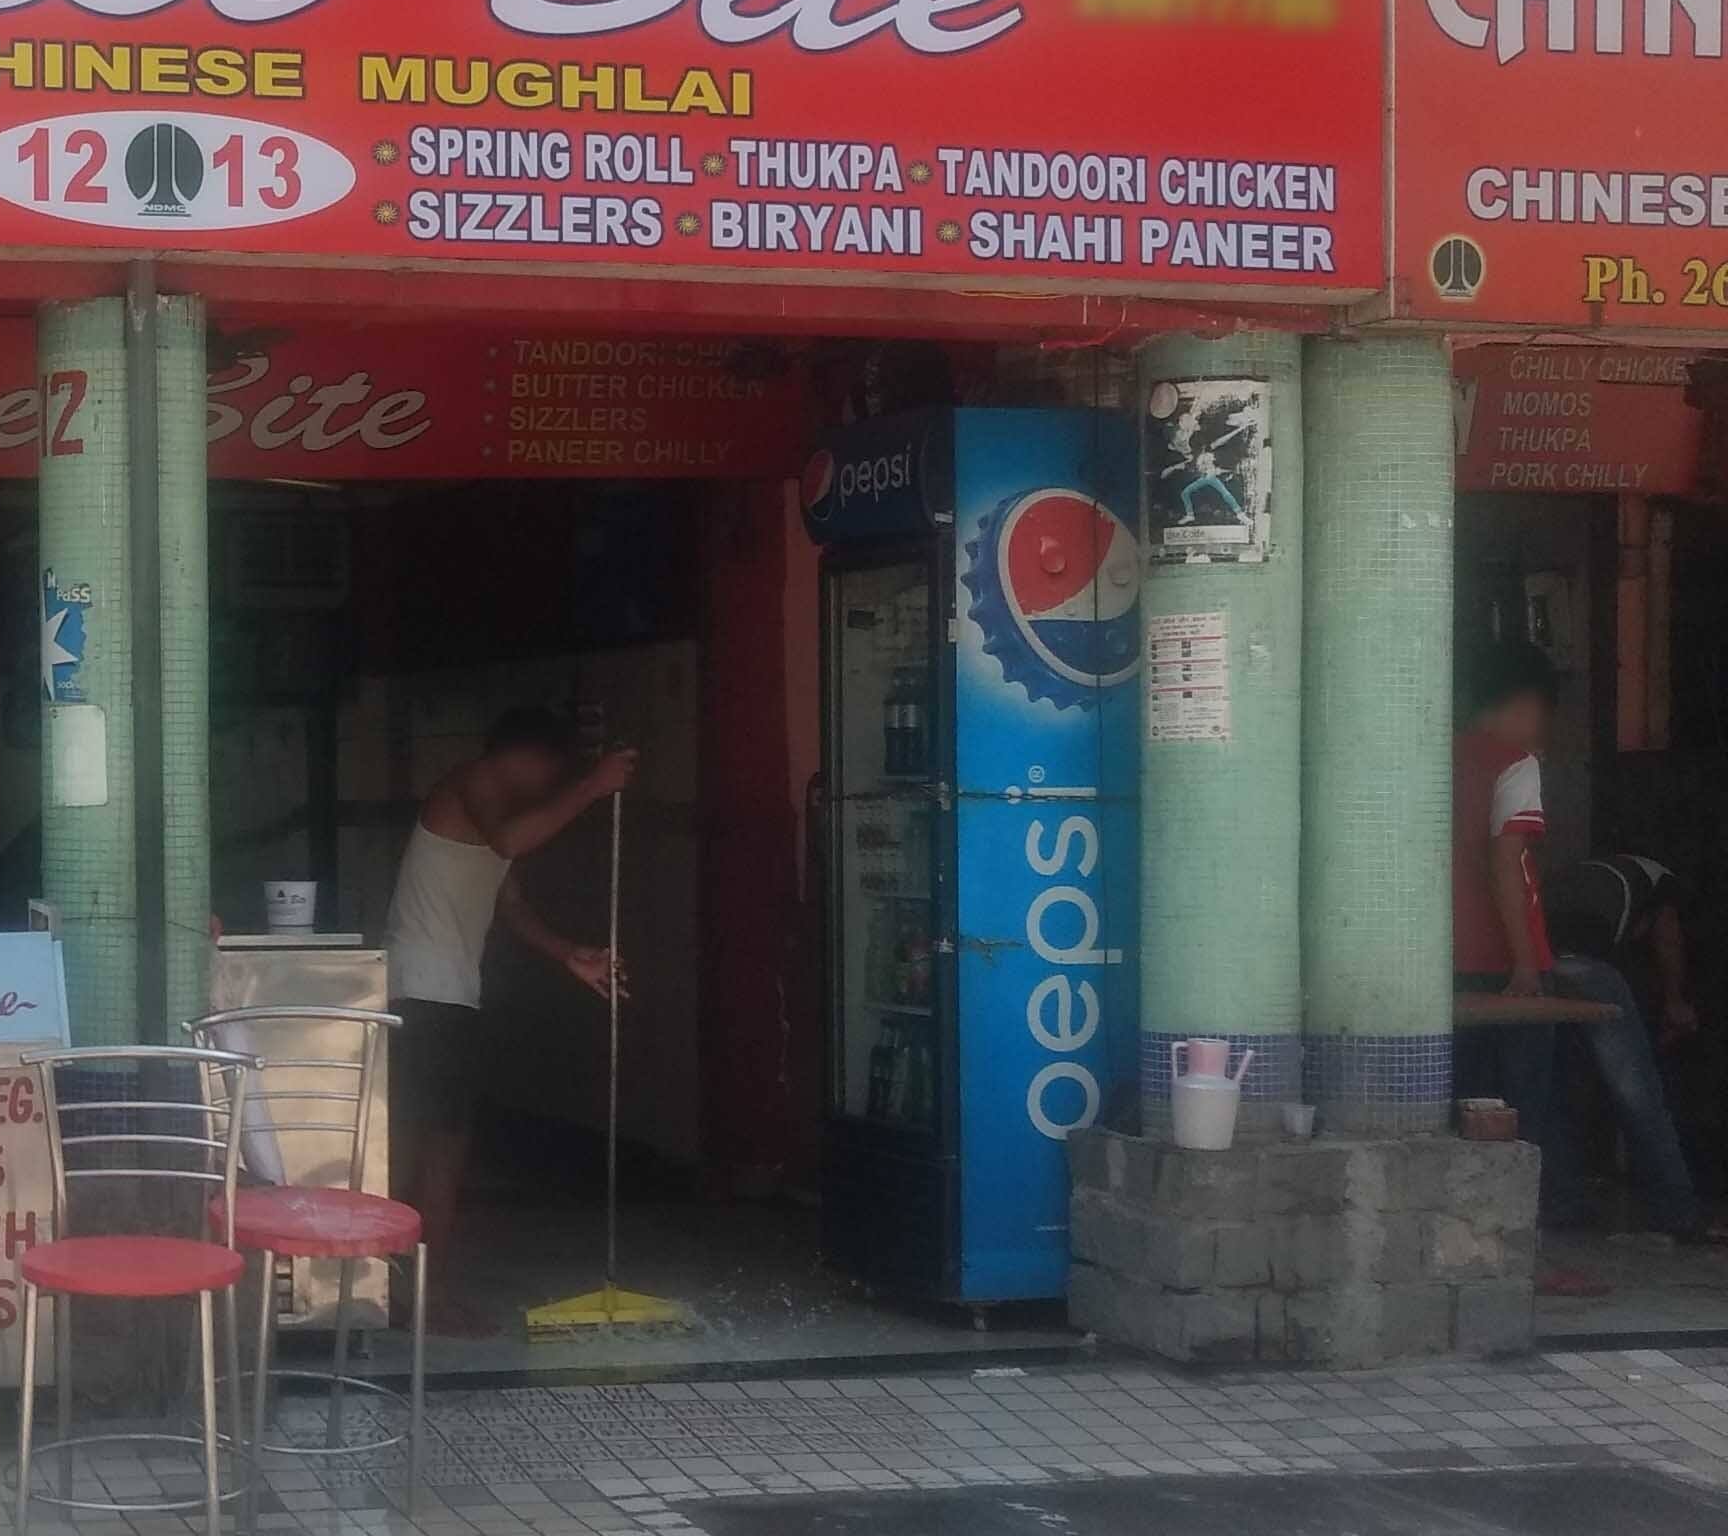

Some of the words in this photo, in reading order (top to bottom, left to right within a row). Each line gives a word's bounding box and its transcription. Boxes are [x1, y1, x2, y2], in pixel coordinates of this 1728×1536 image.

[362, 56, 753, 116] MUGHLAI
[16, 127, 108, 204] 12
[211, 132, 303, 209] 13
[408, 125, 570, 181] SPRING
[576, 134, 694, 185] ROLL
[729, 139, 904, 192] THUKPA
[938, 148, 1146, 203] TANDOORI
[1160, 159, 1335, 212] CHICKEN
[407, 192, 663, 246] SIZZLERS
[710, 201, 922, 255] BIRYANI
[970, 211, 1122, 263] SHAHI
[1140, 219, 1335, 272] PANEER
[1582, 255, 1666, 304] Ph.
[510, 373, 627, 400] BUTTER
[1509, 353, 1594, 382] CHILLY
[1598, 355, 1695, 384] CHICKE
[38, 369, 88, 458] 12
[507, 406, 648, 433] SIZZLERS
[1502, 391, 1593, 417] MOMOS
[506, 439, 625, 465] PANEER
[632, 439, 730, 465] CHILLY
[1497, 426, 1593, 453] THUKPA
[839, 440, 913, 511] pepsi
[1489, 462, 1557, 489] PORK
[1564, 462, 1650, 489] CHILLY
